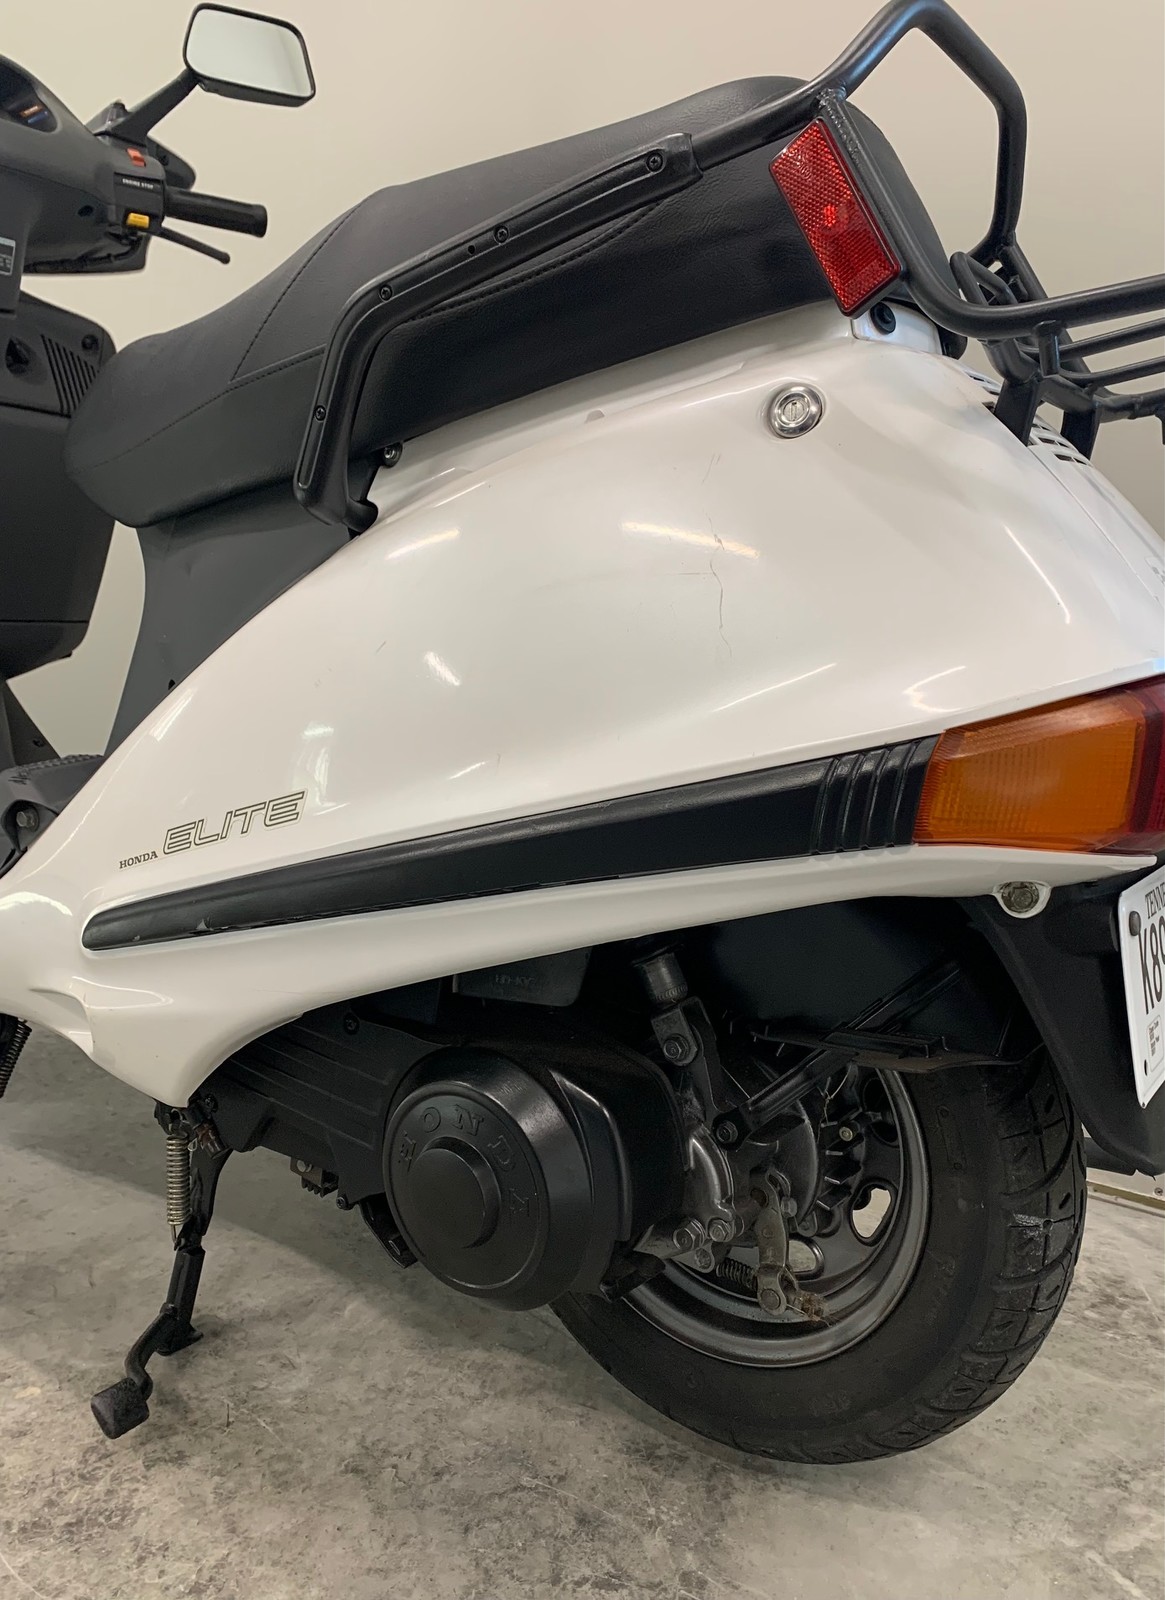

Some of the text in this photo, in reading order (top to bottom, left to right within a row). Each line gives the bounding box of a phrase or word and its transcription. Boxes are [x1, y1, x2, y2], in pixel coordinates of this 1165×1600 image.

[119, 790, 305, 869] HONDA ELITE
[398, 1103, 530, 1218] HONDA
